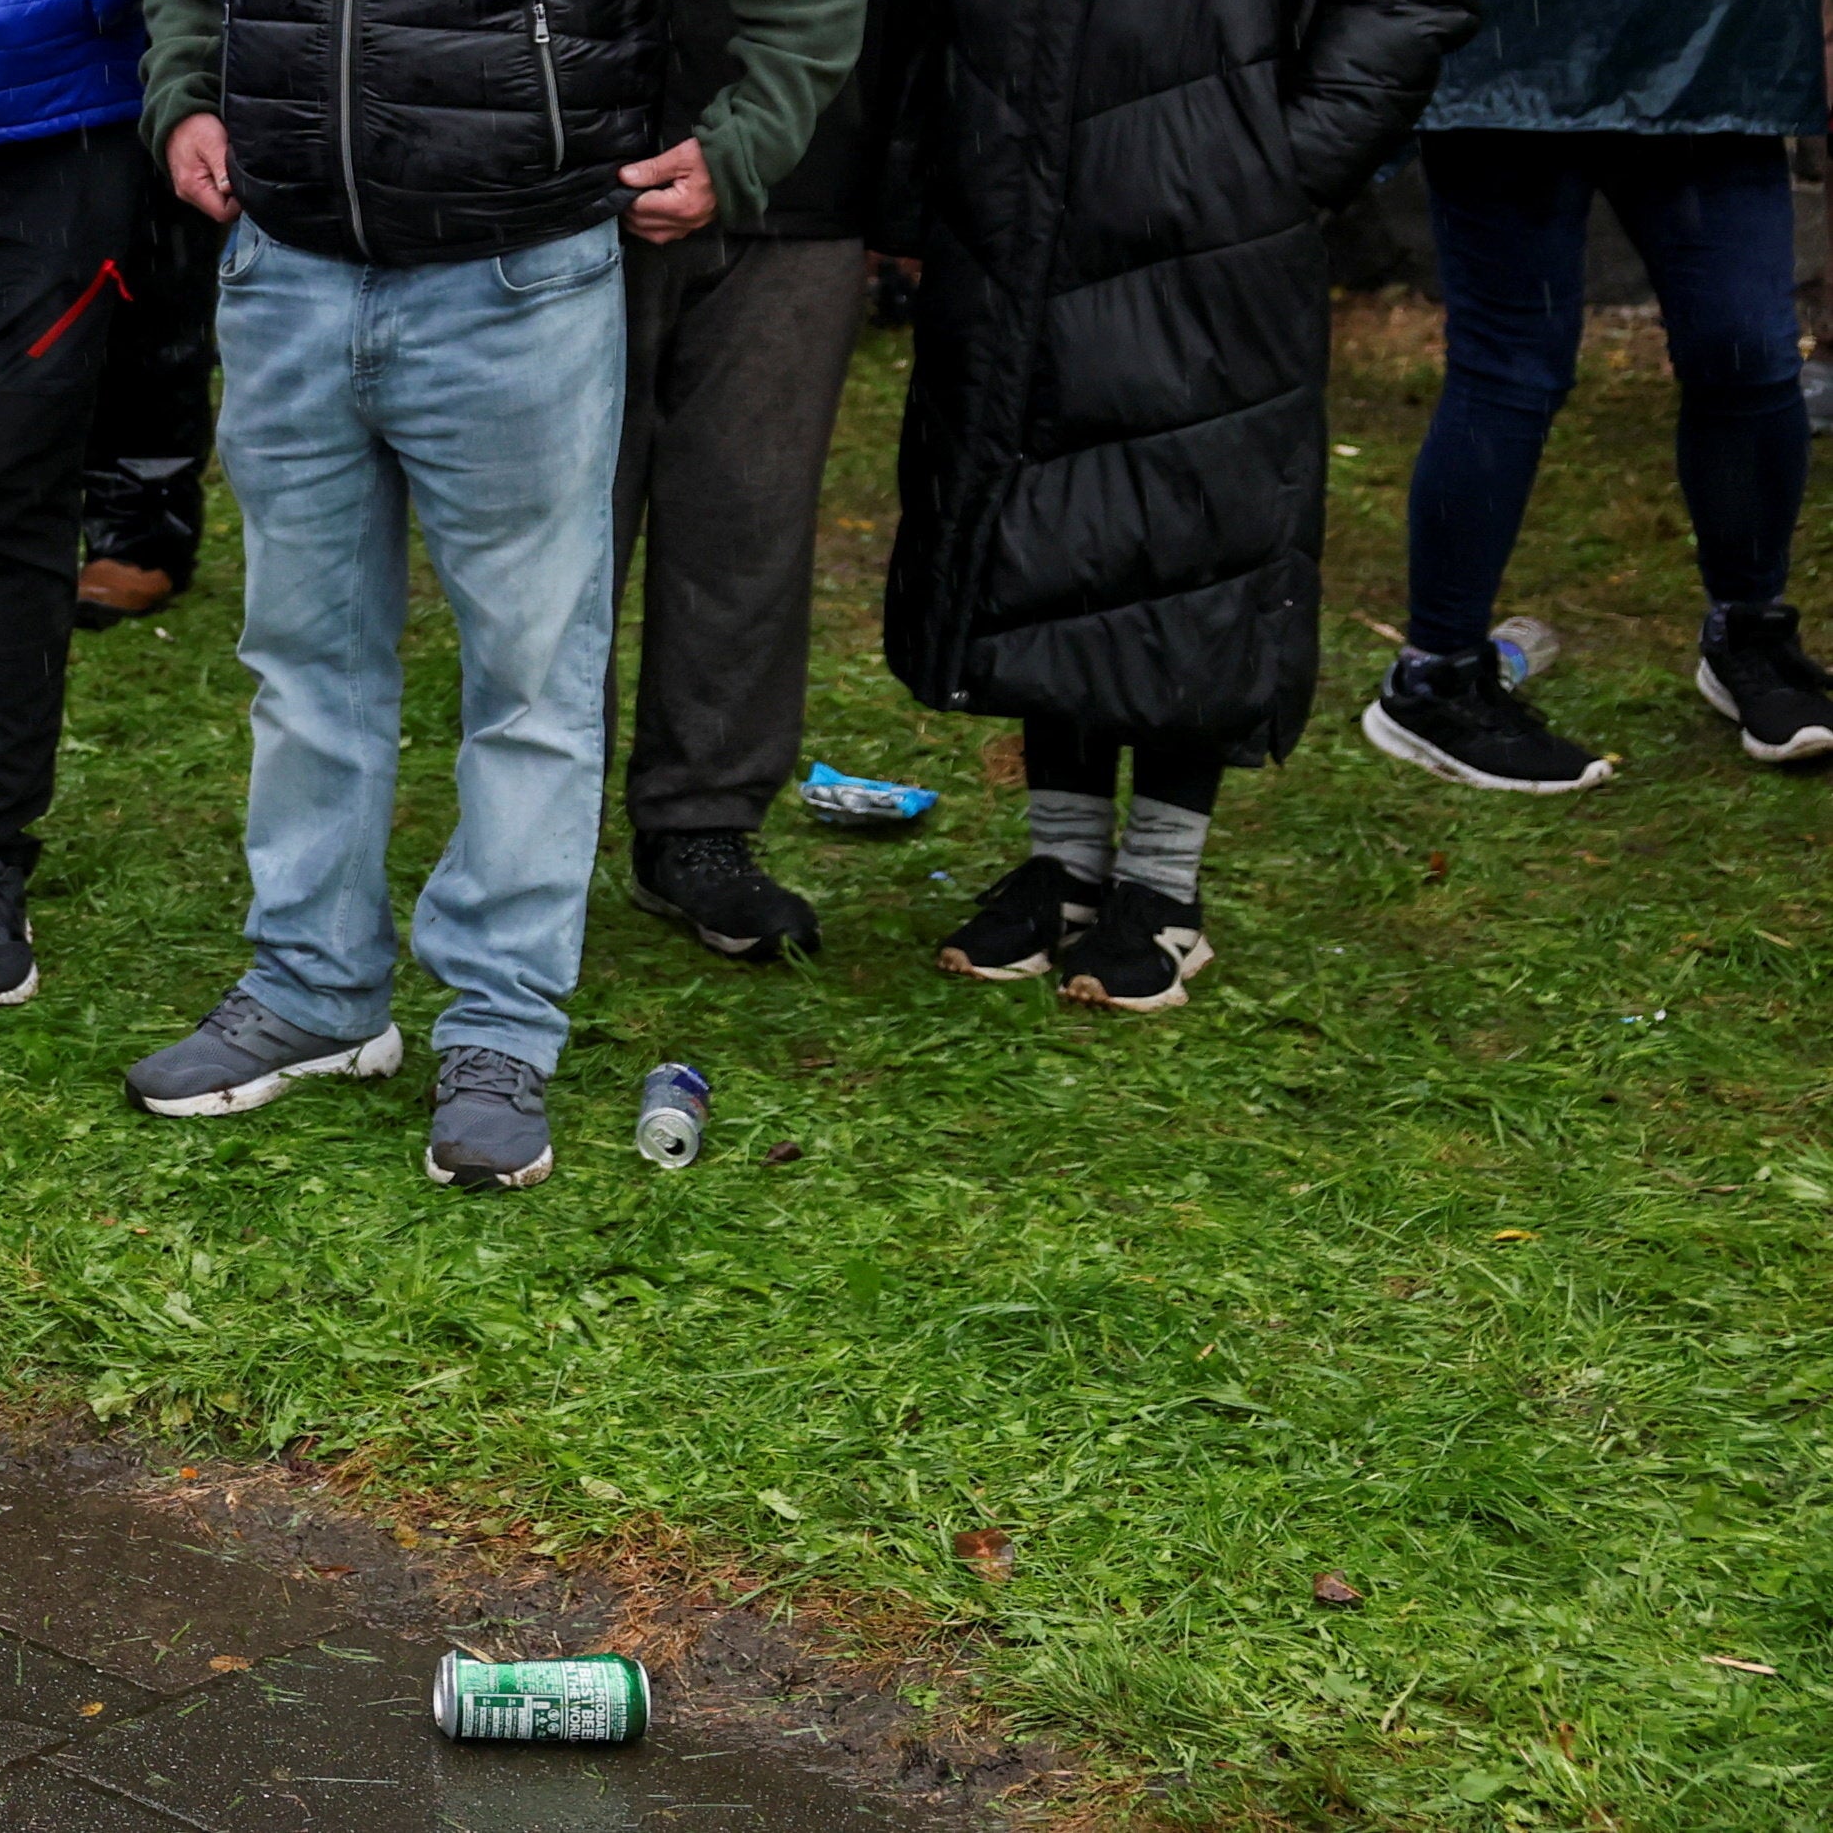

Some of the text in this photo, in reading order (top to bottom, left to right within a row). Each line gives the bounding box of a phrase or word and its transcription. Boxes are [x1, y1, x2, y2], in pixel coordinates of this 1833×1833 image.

[567, 1674, 581, 1700] THE
[578, 1667, 595, 1705] BEST
[594, 1686, 606, 1741] PROBABL
